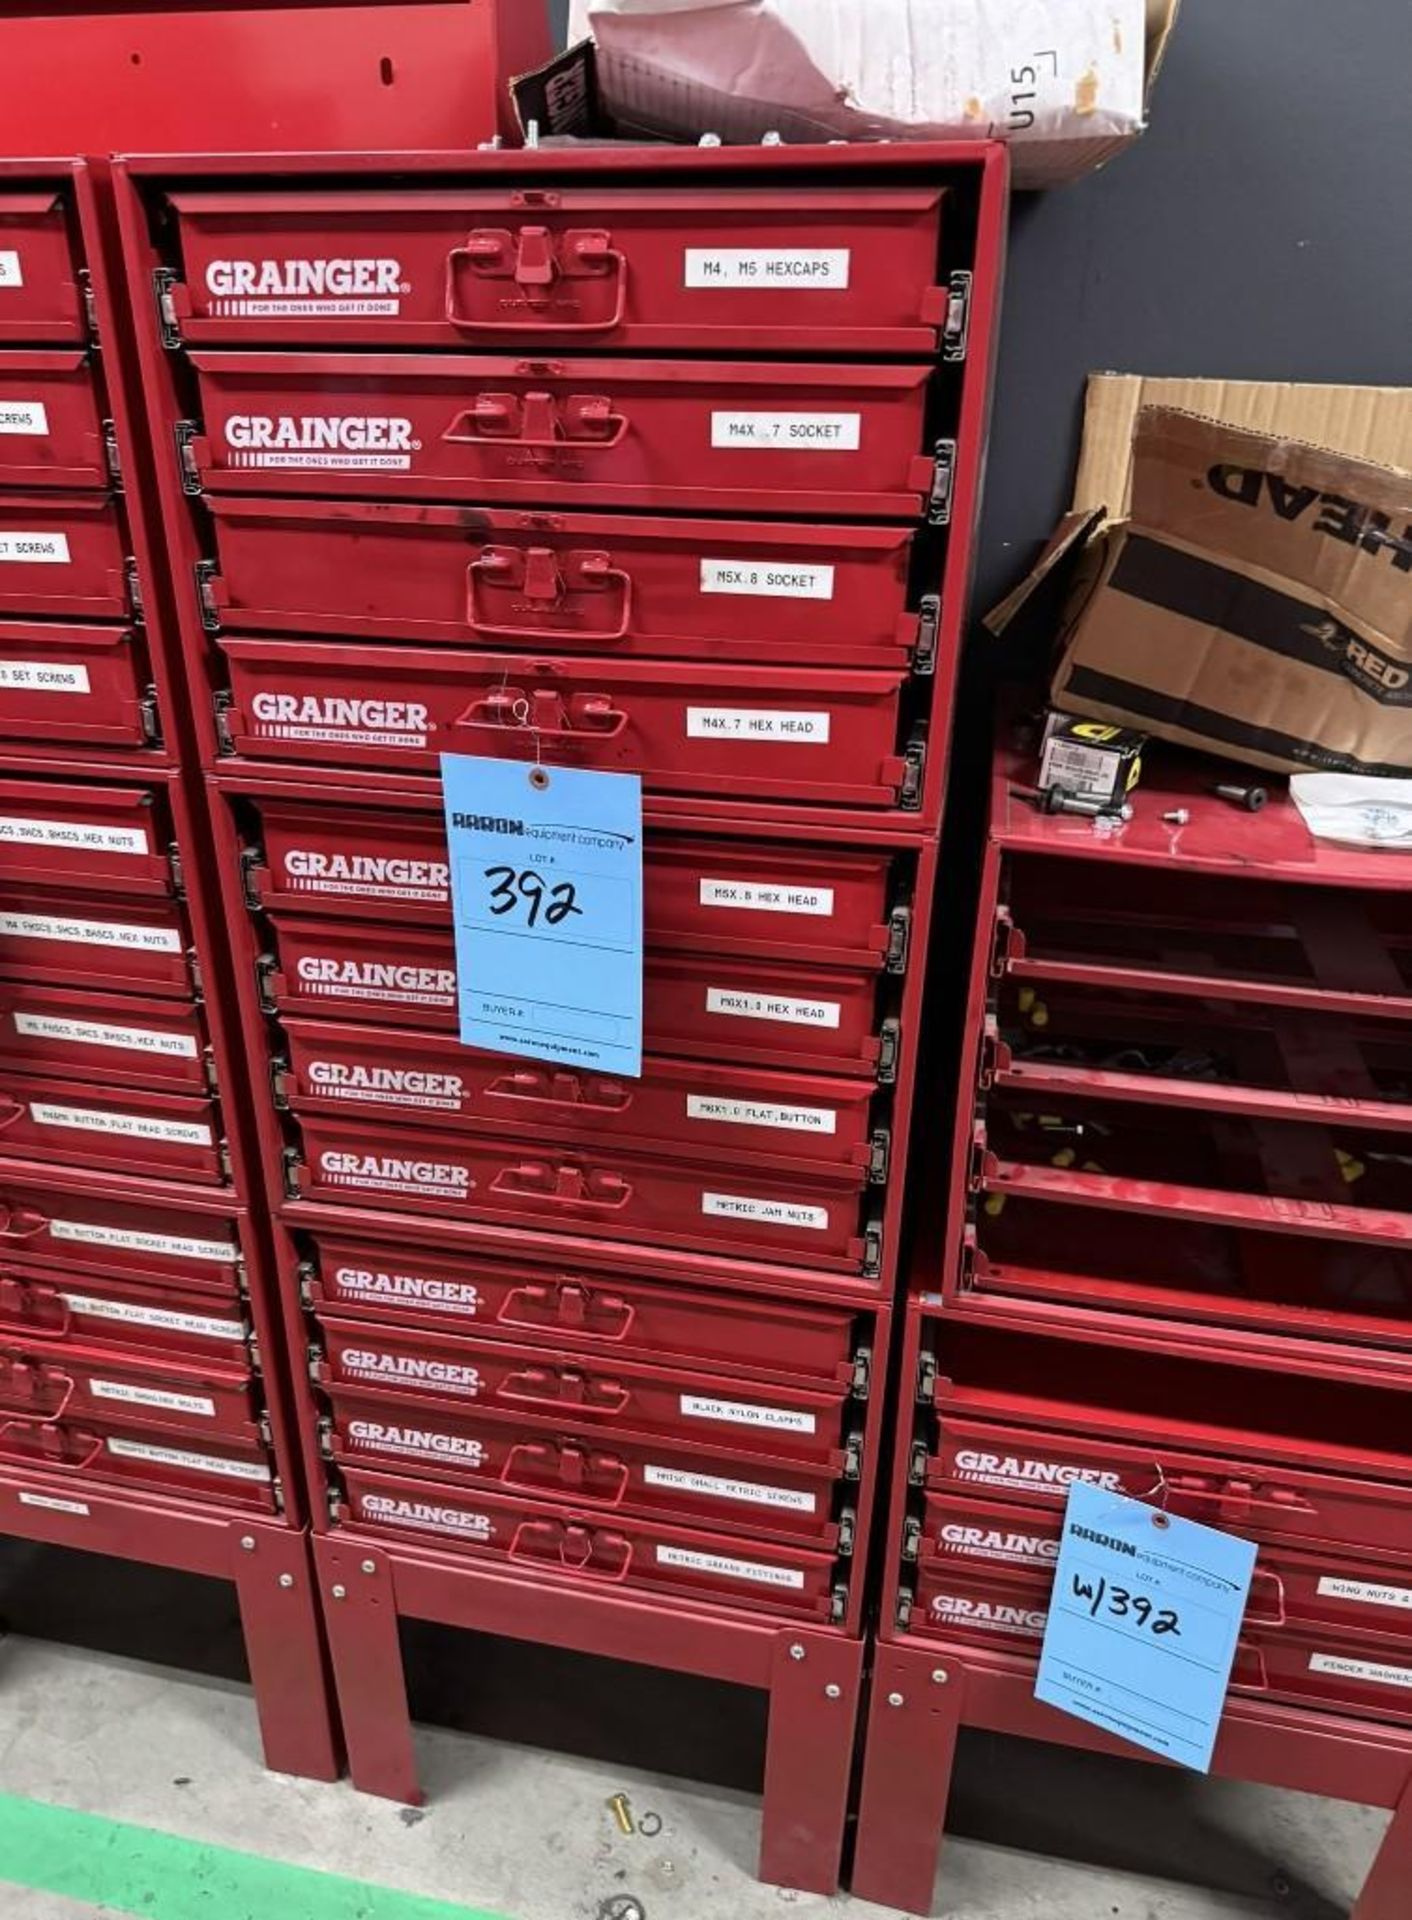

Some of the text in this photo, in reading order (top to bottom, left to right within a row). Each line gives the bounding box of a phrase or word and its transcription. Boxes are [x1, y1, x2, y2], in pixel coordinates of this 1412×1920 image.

[1008, 66, 1037, 130] U15
[206, 259, 401, 296] GRAINGER
[703, 261, 830, 277] M4, M5 HEXCAPS
[225, 415, 412, 450] GRAINGER
[729, 423, 755, 437] M4X
[789, 424, 842, 438] SOCKET
[15, 542, 55, 555] SCREWS
[716, 570, 816, 588] M5X.8 SOCKET
[12, 669, 31, 681] SET
[37, 672, 75, 684] SCREWS
[1346, 638, 1410, 690] RED
[252, 692, 428, 731] GRAINGER
[703, 717, 814, 733] M4X.7 HEX HEAD
[284, 850, 449, 887] GRAINGER
[484, 866, 583, 928] 392
[758, 892, 780, 903] HEX
[788, 895, 818, 907] HEAD
[143, 935, 169, 946] NUTS
[298, 956, 456, 992] GRAINGER
[767, 1003, 790, 1014] HEX
[795, 1007, 825, 1018] HEAD
[160, 1039, 185, 1050] NUTS
[309, 1061, 464, 1097] GRAINGER
[320, 1151, 470, 1187] GRAINGER
[716, 1200, 814, 1222] METRIC JAM NUTS
[336, 1268, 478, 1304] GRAINGER
[341, 1348, 479, 1386] GRAINGER
[728, 1407, 760, 1421] NYLON
[349, 1421, 482, 1457] GRAINGER
[955, 1450, 1120, 1490] GRAINGER
[362, 1494, 491, 1531] GRAINGER
[941, 1524, 1061, 1555] GRAING
[932, 1595, 1048, 1627] GRAING
[1366, 1589, 1396, 1601] NUTS
